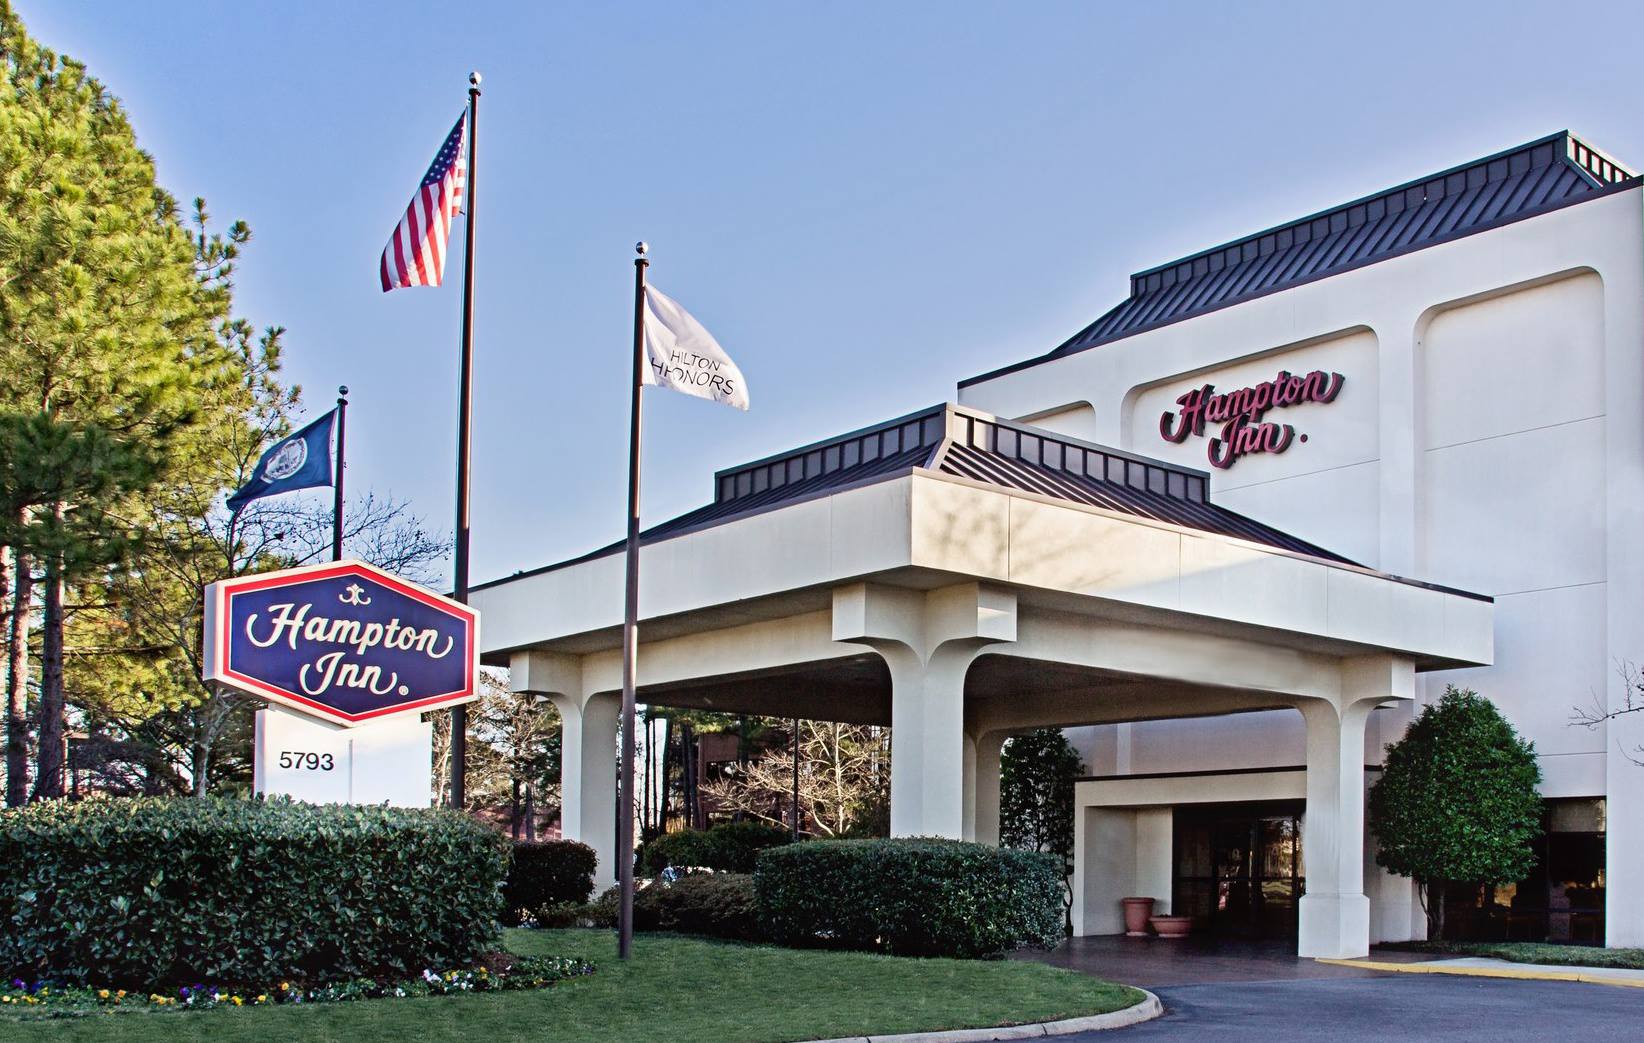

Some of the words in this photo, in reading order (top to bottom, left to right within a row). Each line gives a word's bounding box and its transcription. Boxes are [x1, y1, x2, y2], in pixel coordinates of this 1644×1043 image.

[670, 350, 721, 371] HILTON
[1160, 370, 1345, 443] Hampton
[246, 603, 454, 659] Hampton
[279, 751, 335, 771] 5793
